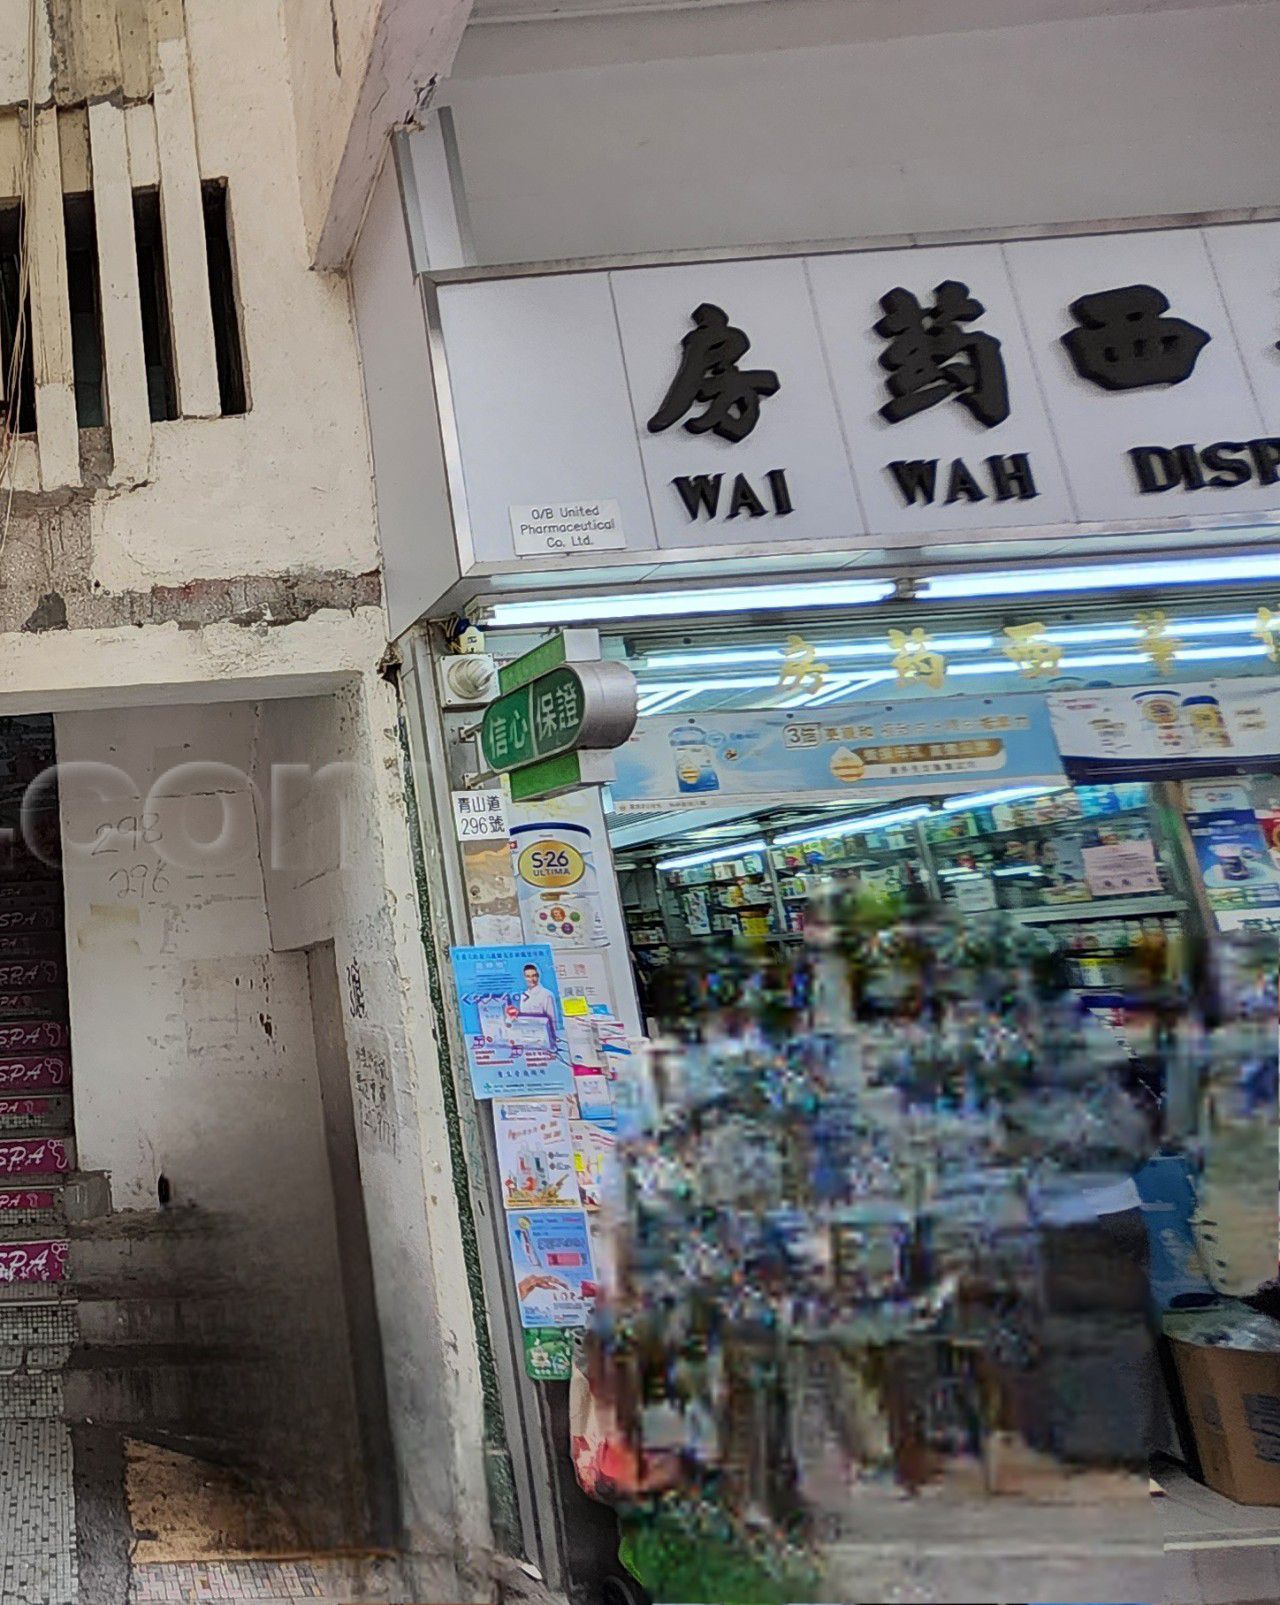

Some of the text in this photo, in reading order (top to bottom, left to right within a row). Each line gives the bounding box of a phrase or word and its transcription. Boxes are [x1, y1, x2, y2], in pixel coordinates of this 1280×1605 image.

[670, 468, 795, 522] WAI
[886, 452, 1040, 507] WAH
[560, 505, 600, 518] United
[520, 518, 616, 535] Pharmaceutical
[546, 535, 594, 548] Co. Ltd.
[458, 795, 502, 813] 青山道
[461, 815, 506, 836] 296號
[530, 850, 570, 869] S-26
[532, 868, 571, 877] ULTIMA
